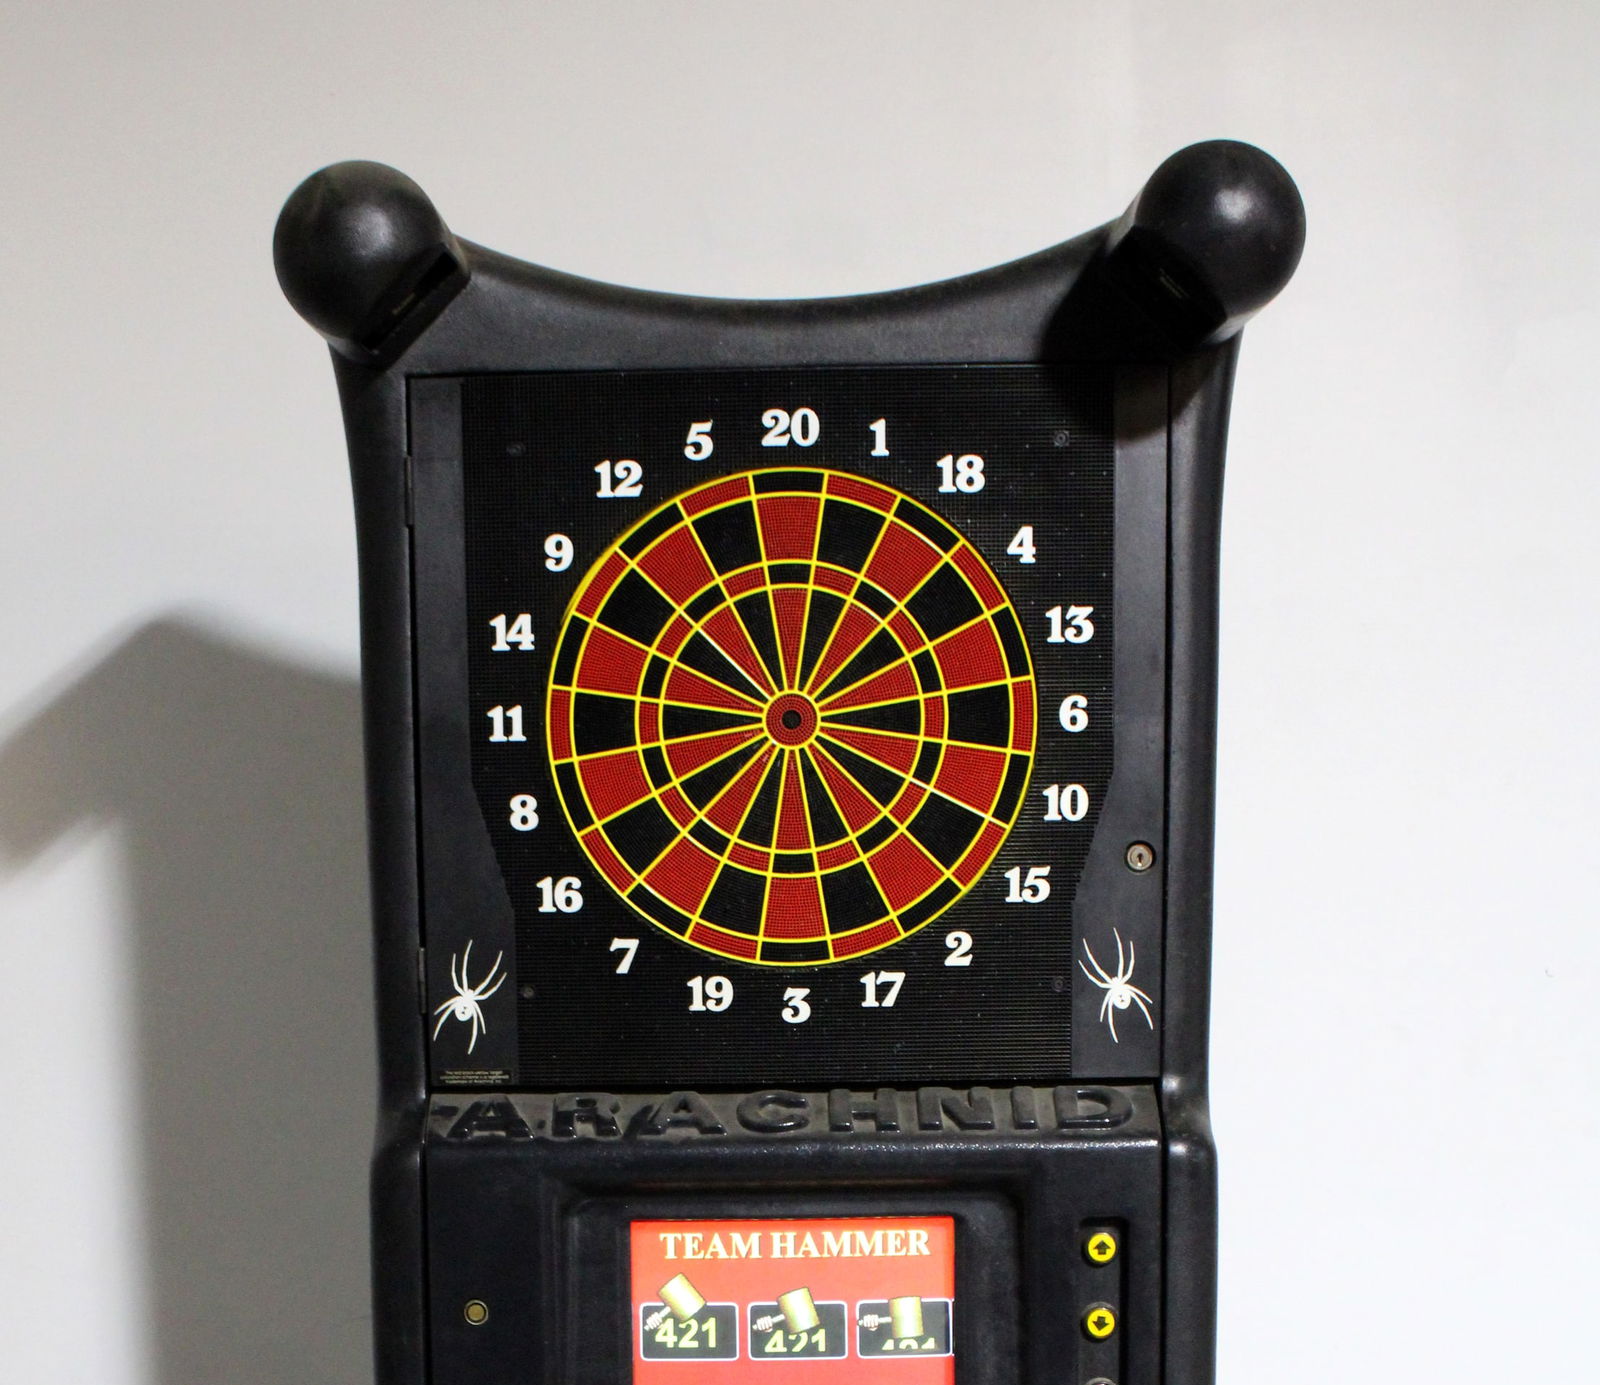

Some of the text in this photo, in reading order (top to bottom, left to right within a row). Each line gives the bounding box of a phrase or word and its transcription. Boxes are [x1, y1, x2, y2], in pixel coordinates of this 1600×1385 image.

[684, 419, 714, 460] 5
[761, 407, 820, 447] 20
[869, 418, 890, 457] 1
[594, 460, 644, 498] 12
[936, 454, 986, 493] 18
[544, 534, 574, 572] 9
[1006, 526, 1037, 564] 4
[489, 613, 535, 651] 14
[1045, 605, 1095, 644] 13
[486, 705, 527, 742] 11
[1058, 694, 1089, 733] 6
[509, 794, 539, 832] 8
[1042, 783, 1089, 822] 10
[536, 876, 584, 913] 16
[1003, 865, 1051, 904] 15
[609, 937, 640, 974] 7
[944, 930, 973, 967] 2
[686, 975, 734, 1012] 19
[781, 987, 811, 1024] 3
[859, 970, 906, 1008] 17
[445, 1087, 1134, 1140] ARACHNID
[659, 1229, 930, 1260] TEAM HAMMER
